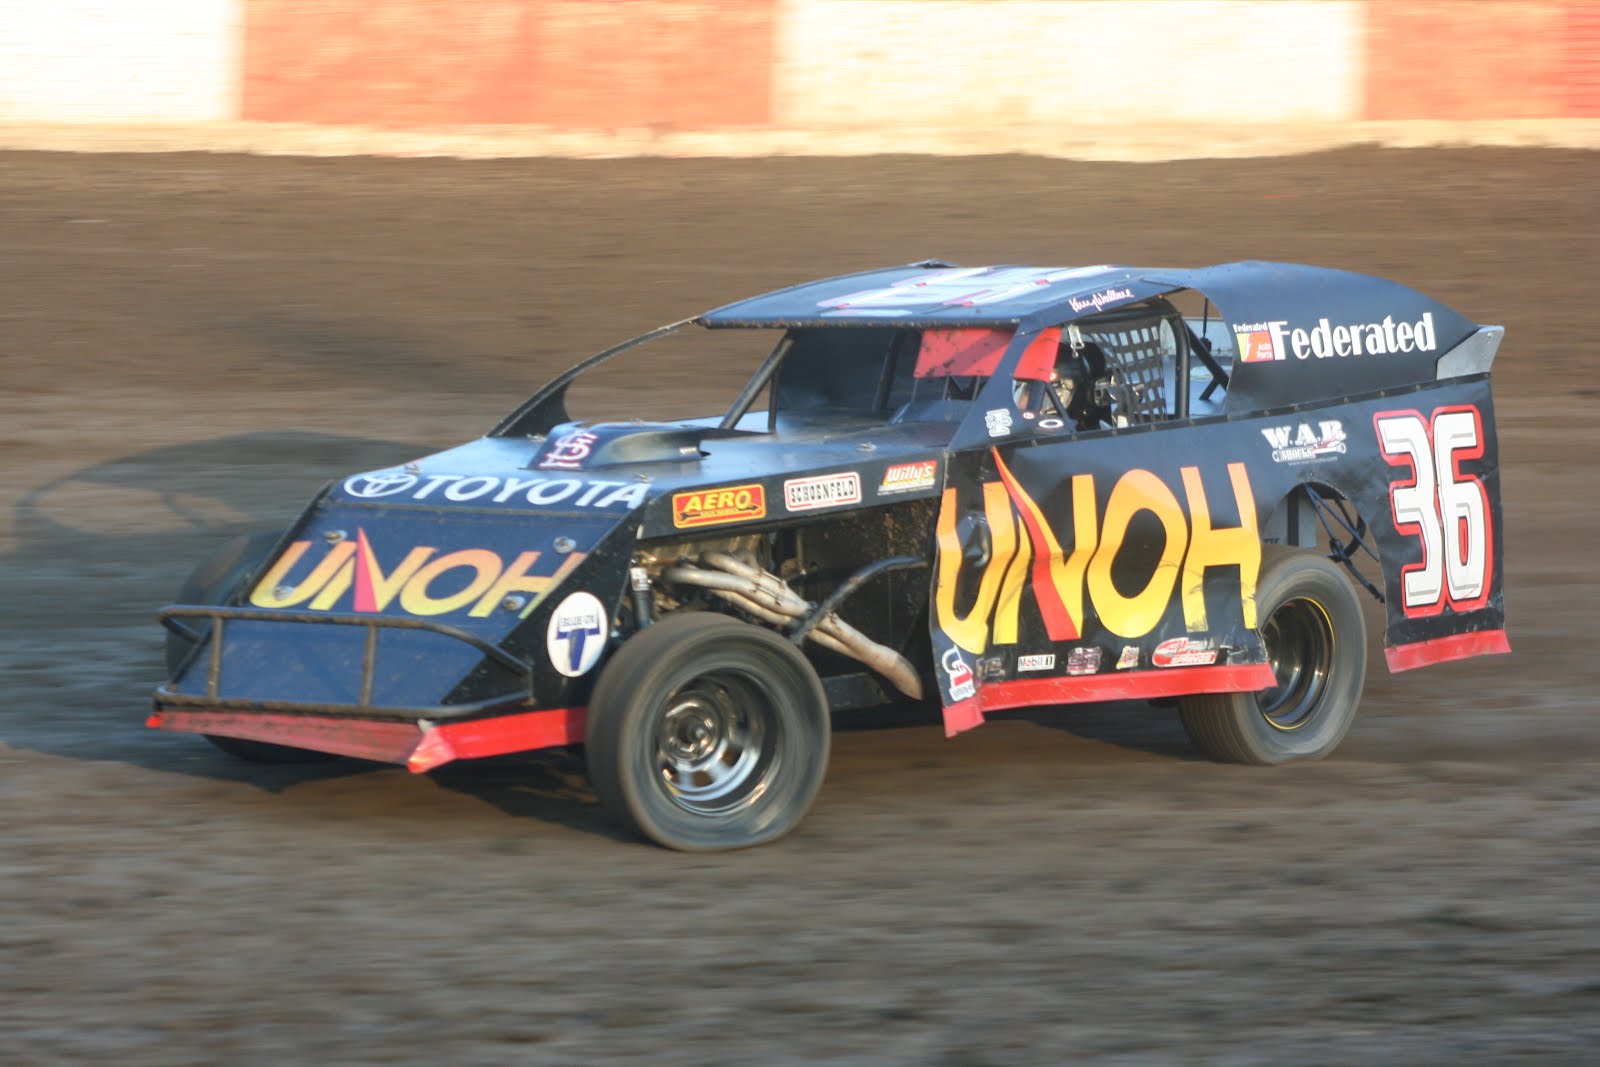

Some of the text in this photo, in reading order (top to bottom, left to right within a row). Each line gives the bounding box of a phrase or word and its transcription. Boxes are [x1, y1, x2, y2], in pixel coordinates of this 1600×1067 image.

[1232, 321, 1268, 333] Federated
[1267, 312, 1436, 361] Federated
[886, 461, 934, 483] Willy's
[411, 474, 652, 509] TOYOTA
[685, 489, 752, 513] AERO
[790, 480, 855, 504] SCHOENFELD
[1373, 404, 1494, 619] 36
[935, 445, 1261, 655] UNOH
[250, 526, 588, 619] UNOH
[1019, 656, 1043, 669] Mobil
[1169, 653, 1214, 665] SPRINGS
